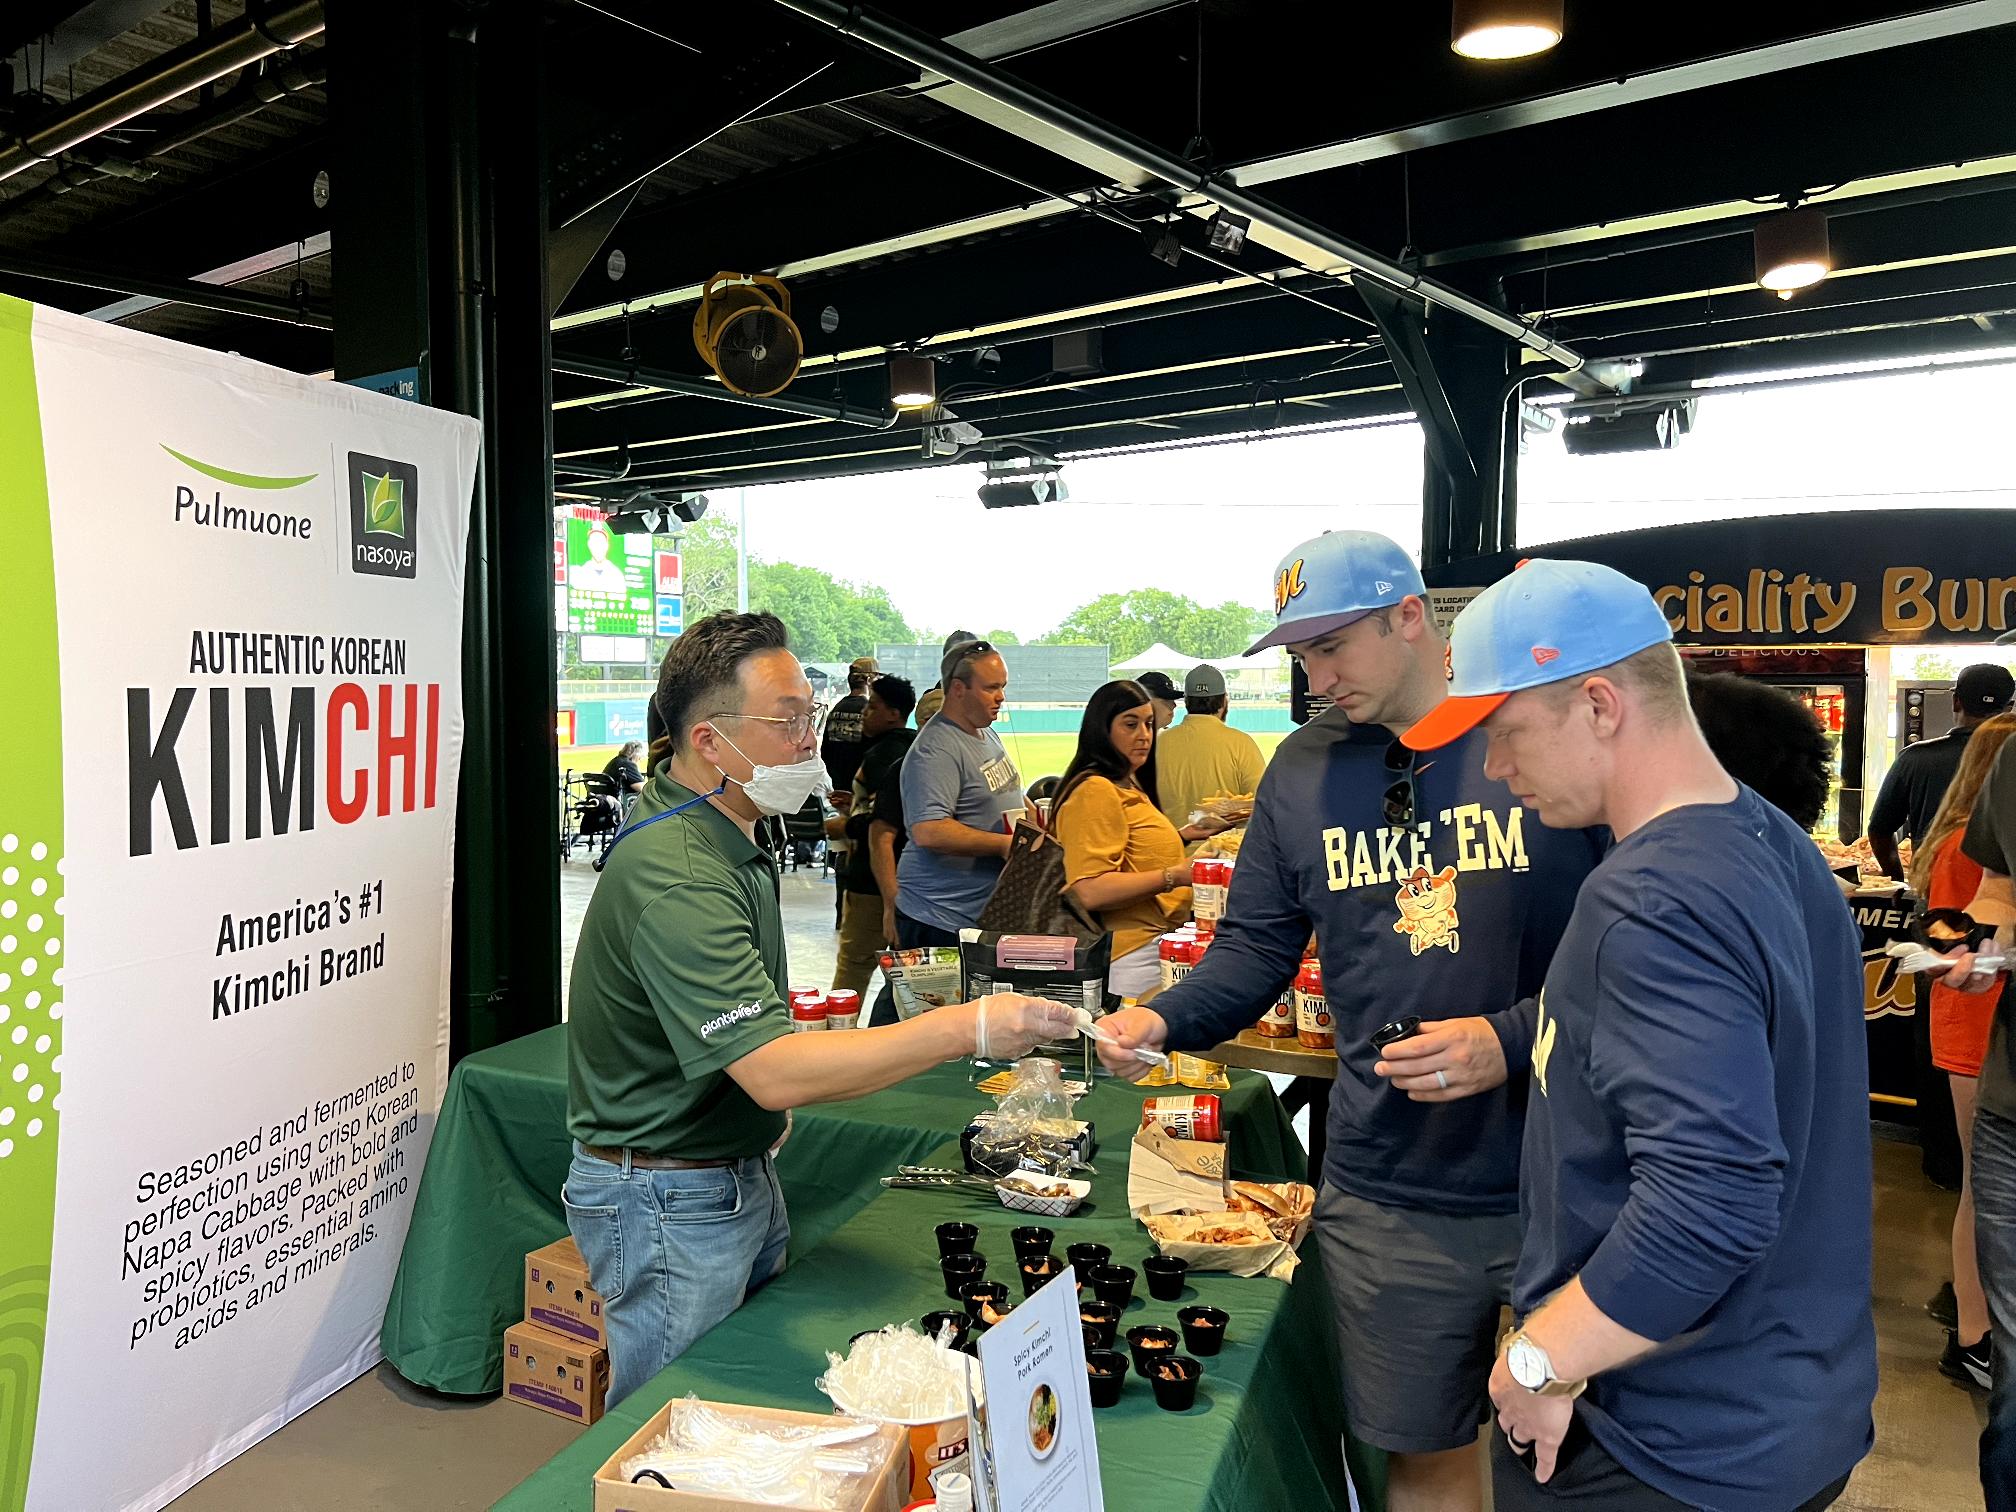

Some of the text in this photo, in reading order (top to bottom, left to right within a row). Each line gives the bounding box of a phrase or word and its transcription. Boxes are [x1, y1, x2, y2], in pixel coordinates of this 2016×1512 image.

[175, 486, 312, 539] Pulmuone
[357, 544, 412, 570] nasoya
[190, 630, 406, 675] AUTHENTIC KOREAN
[127, 683, 440, 857] KIMCHI
[1322, 821, 1434, 891] BAKE
[216, 880, 383, 956] America's #1
[213, 932, 384, 1020] Kimchi Brand
[701, 1000, 761, 1038] plantspired
[124, 1087, 418, 1249] perfection using crisp Korean
[137, 1062, 415, 1203] Seasoned and fermented to
[122, 1109, 418, 1280] Napa Cabbage with bold and
[143, 1148, 404, 1303] spicy flavors. Packed with
[131, 1176, 408, 1350] probiotics, essential amino
[175, 1222, 378, 1350] acids and minerals.
[1013, 1327, 1051, 1366] Spicy Kimchi
[1017, 1362, 1031, 1381] Pork
